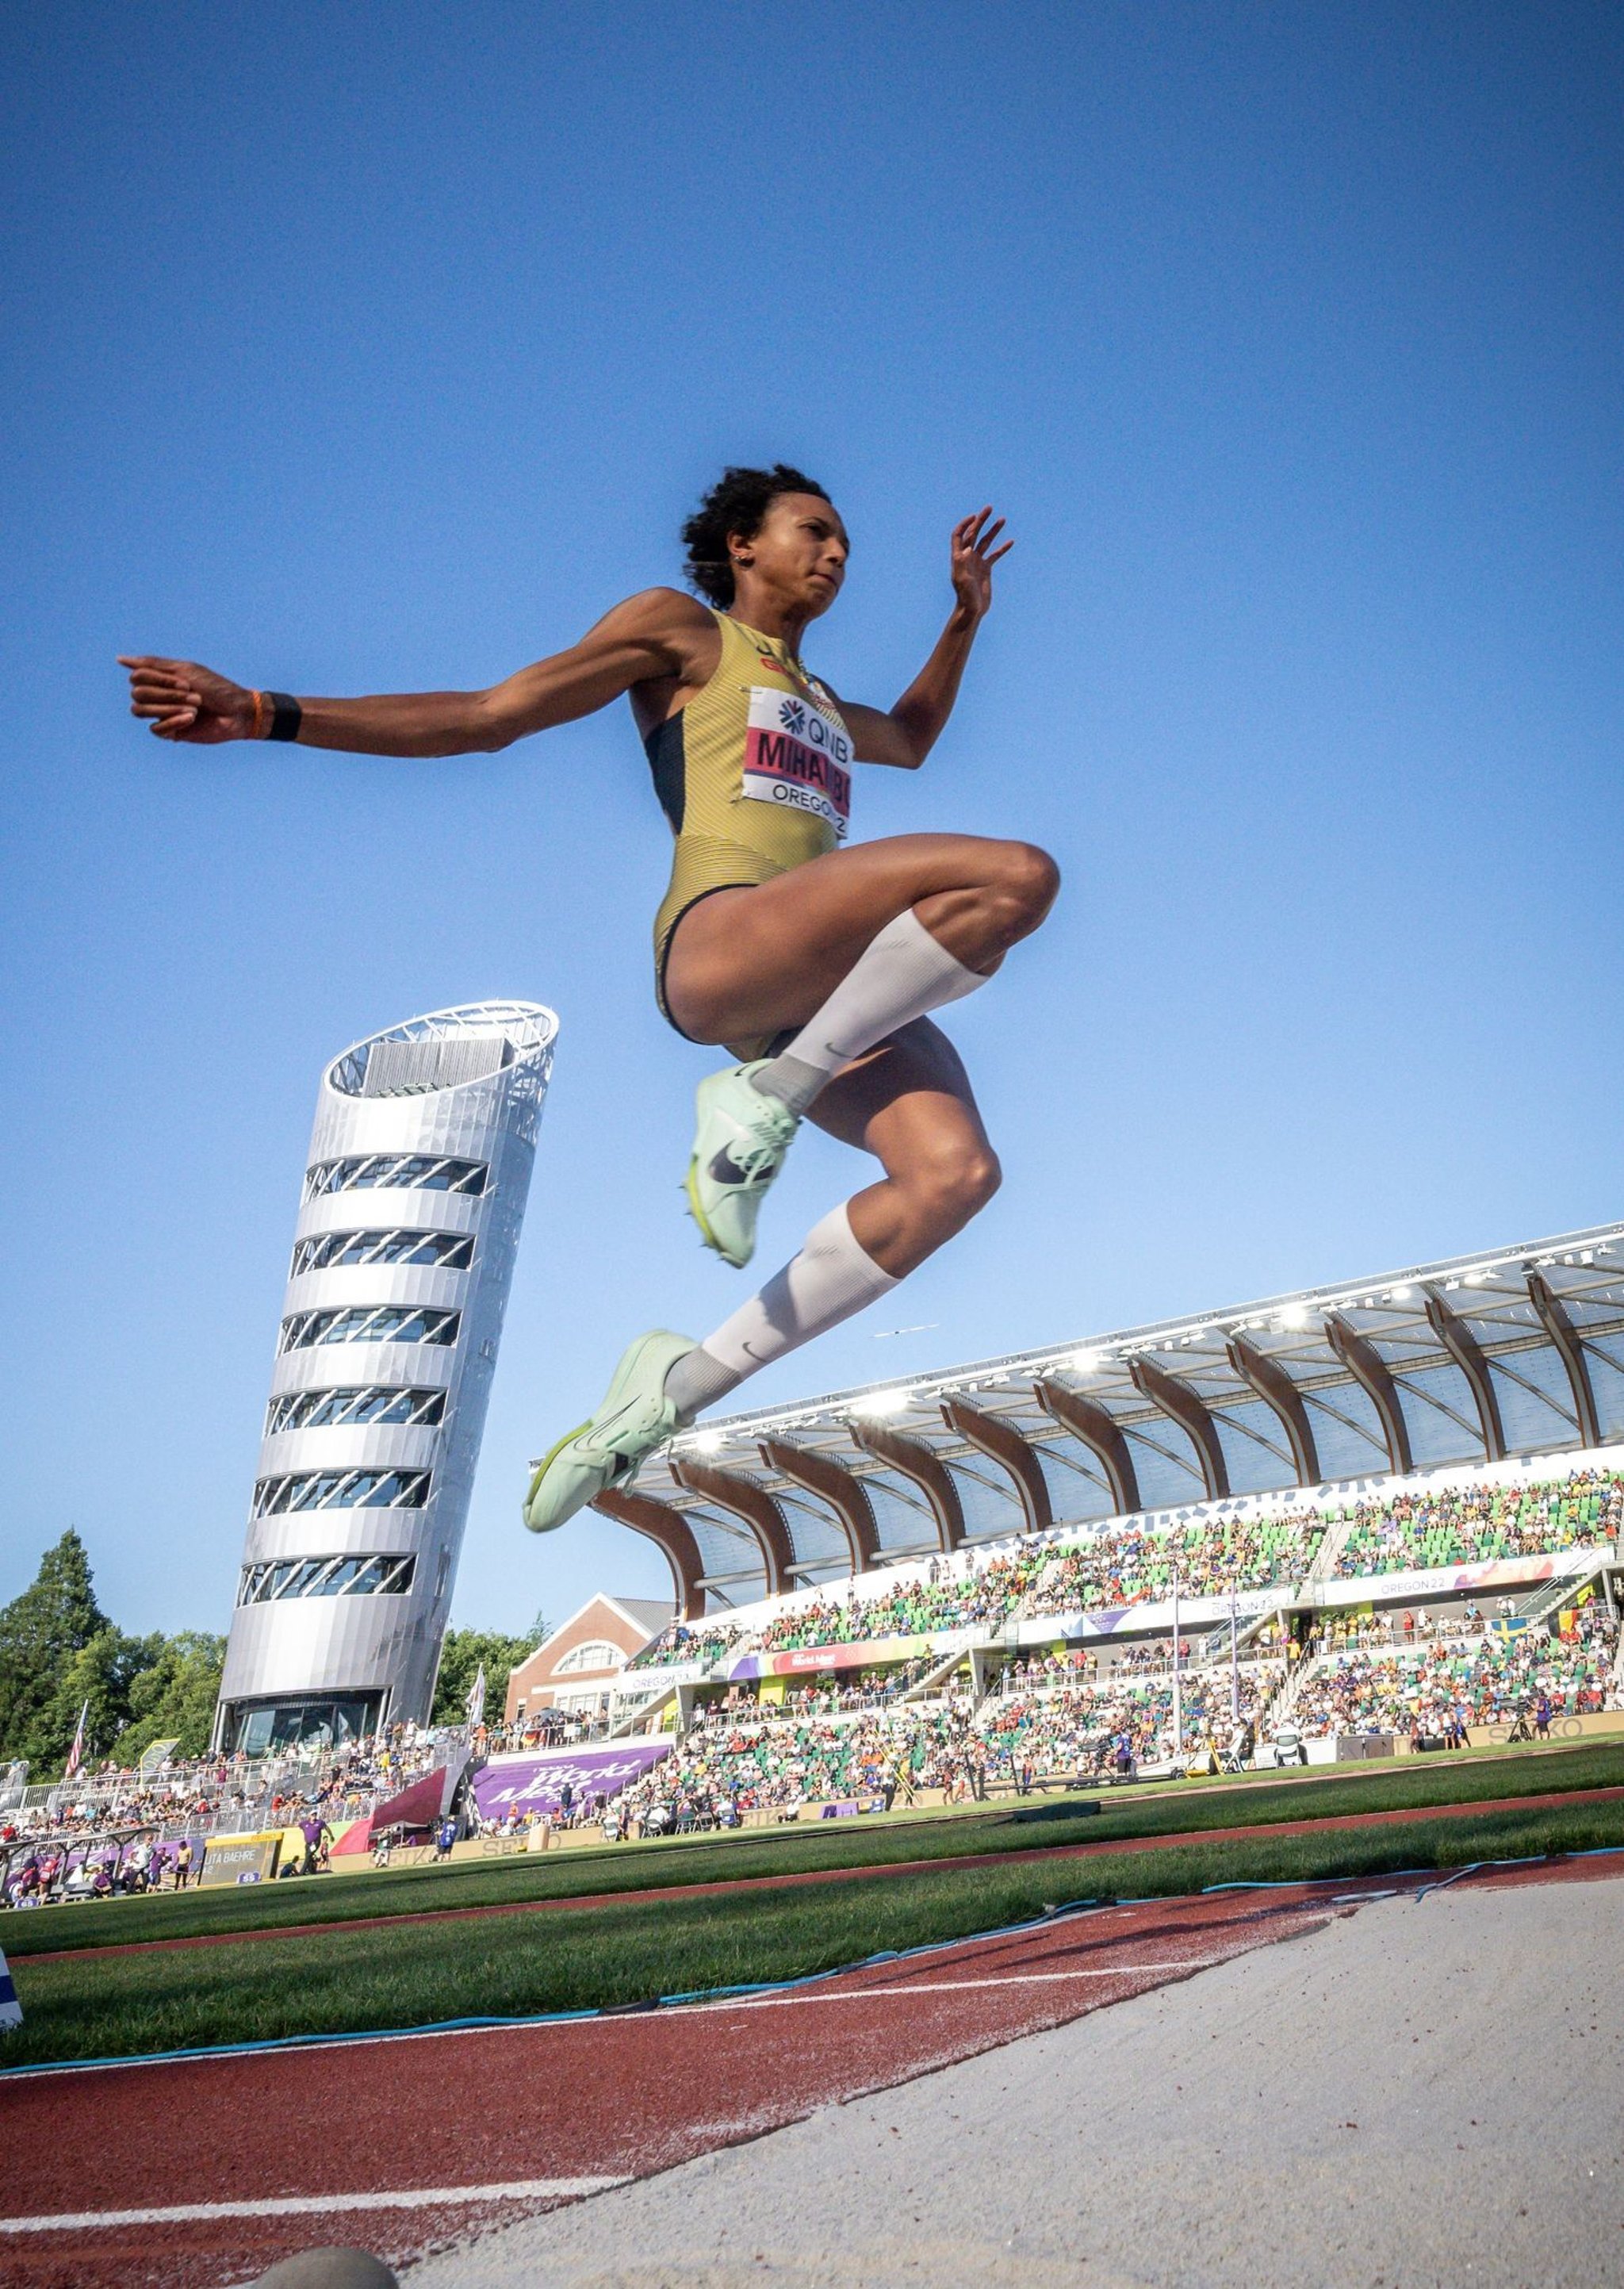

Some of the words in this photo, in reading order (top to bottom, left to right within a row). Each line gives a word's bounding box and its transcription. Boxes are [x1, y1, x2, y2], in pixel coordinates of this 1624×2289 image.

[808, 718, 848, 764] QNB
[1381, 1577, 1445, 1594] OREGON22
[1488, 1718, 1583, 1745] SKO
[224, 1850, 256, 1863] BAEHRE
